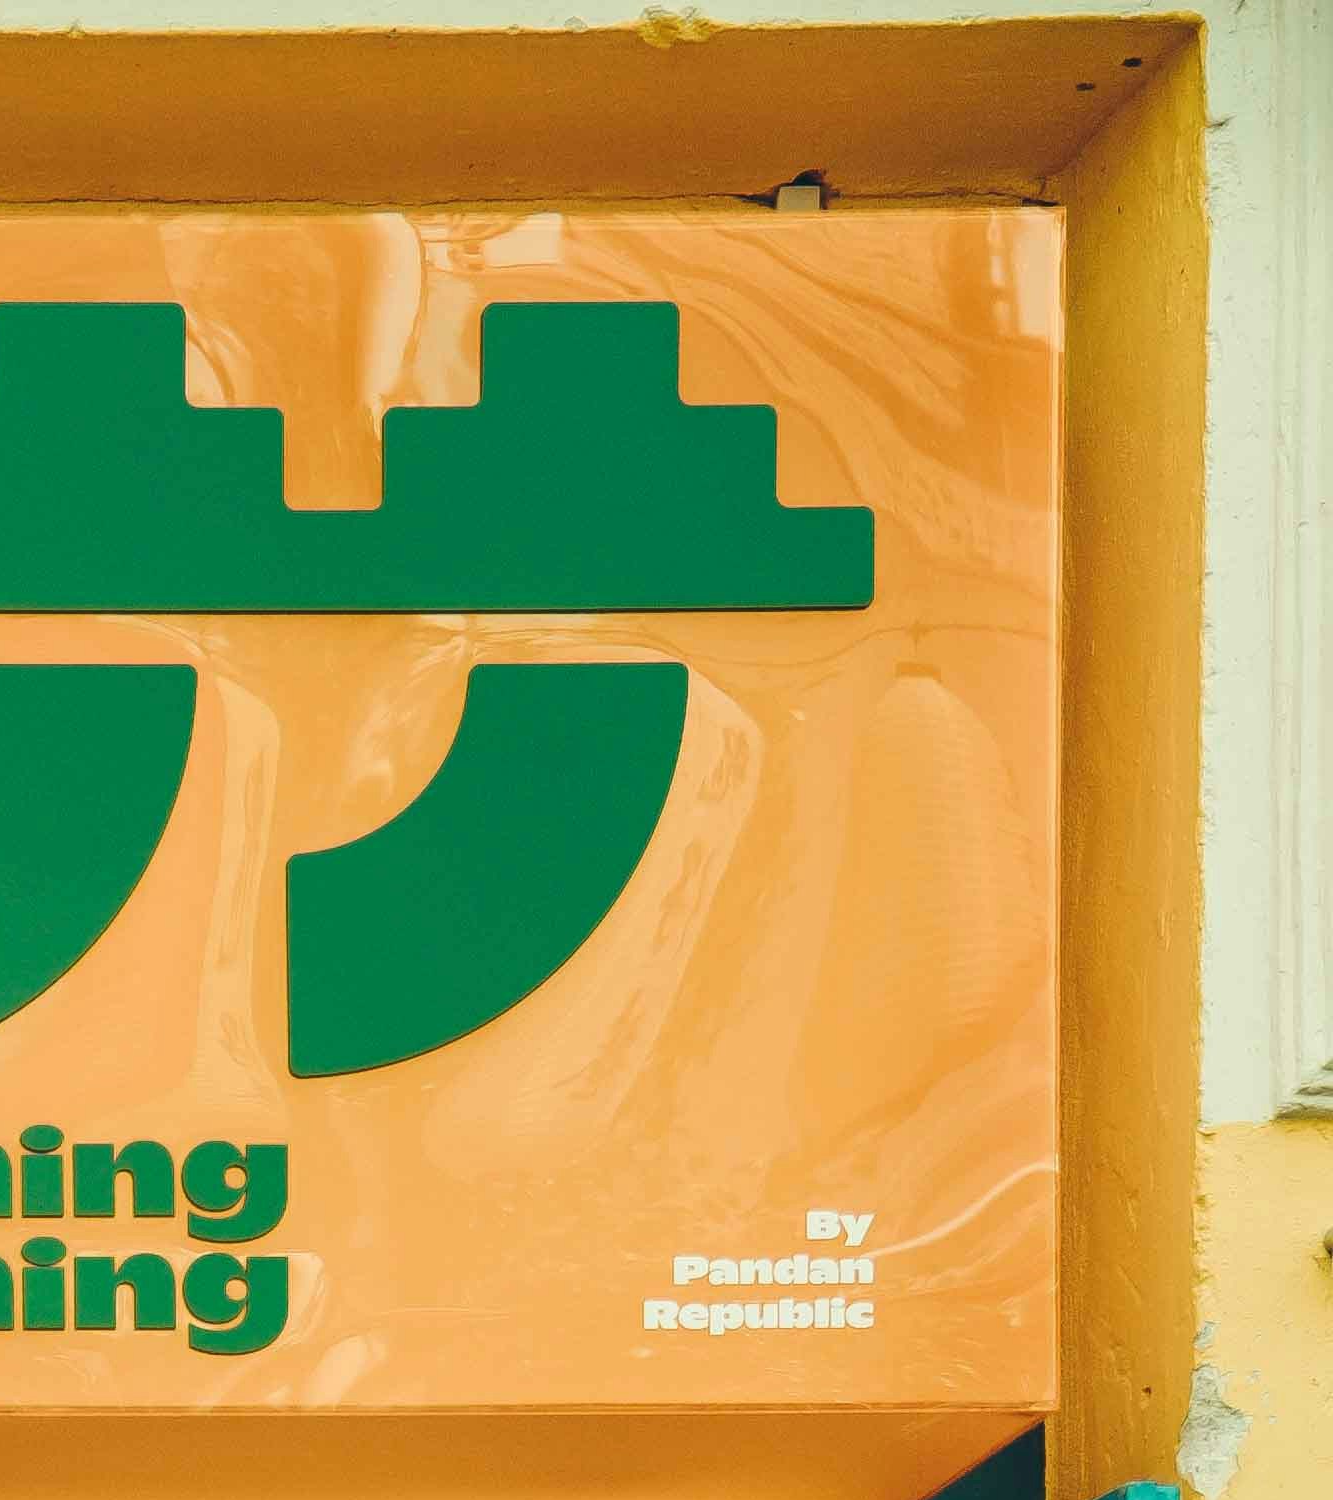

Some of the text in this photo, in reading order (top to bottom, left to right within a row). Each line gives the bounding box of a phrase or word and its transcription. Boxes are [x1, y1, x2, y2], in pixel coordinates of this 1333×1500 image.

[805, 1210, 876, 1247] By
[673, 1253, 875, 1286] Pandan
[642, 1297, 875, 1336] Republic
